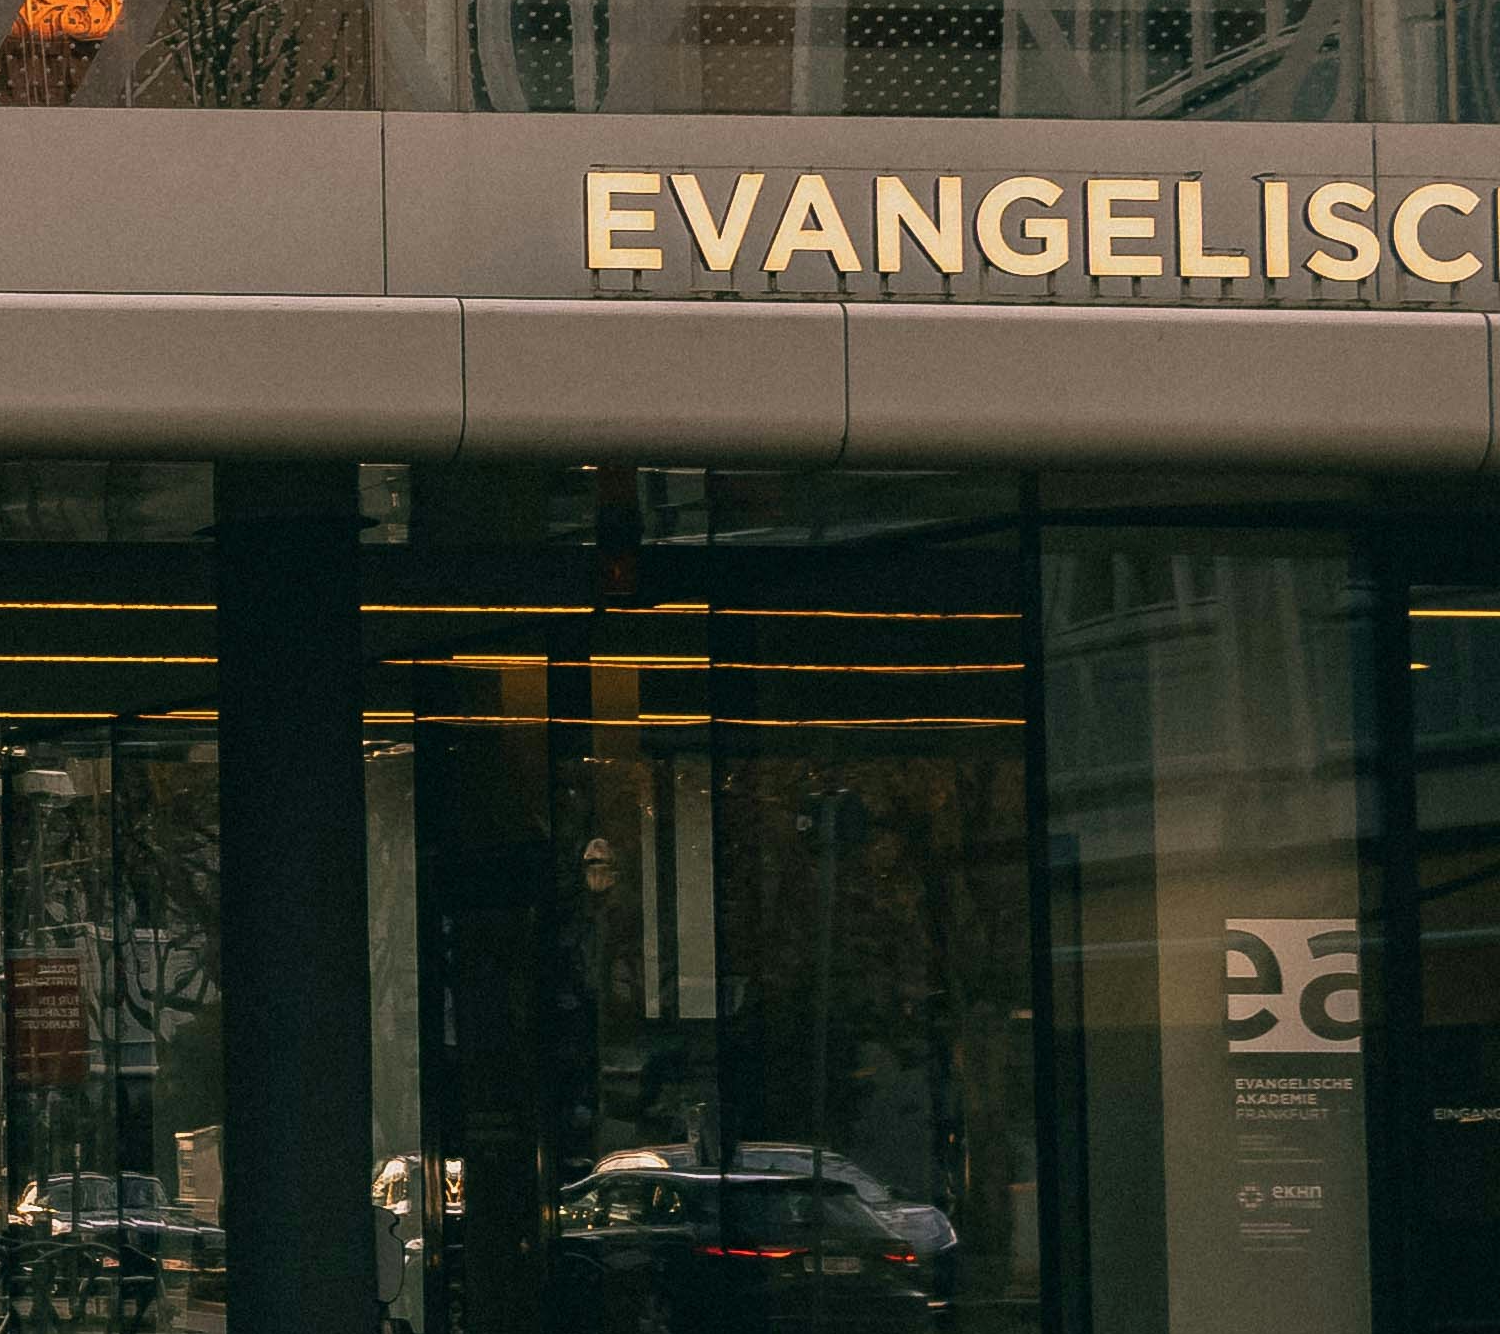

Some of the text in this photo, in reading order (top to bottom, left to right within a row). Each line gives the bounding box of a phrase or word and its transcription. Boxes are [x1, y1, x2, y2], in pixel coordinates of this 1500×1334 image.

[586, 172, 1500, 283] EVANGELISC
[1235, 1078, 1353, 1090] EVANGELISCHE
[1235, 1093, 1317, 1105] AKADEMIE
[1236, 1108, 1327, 1122] FRANKFURT
